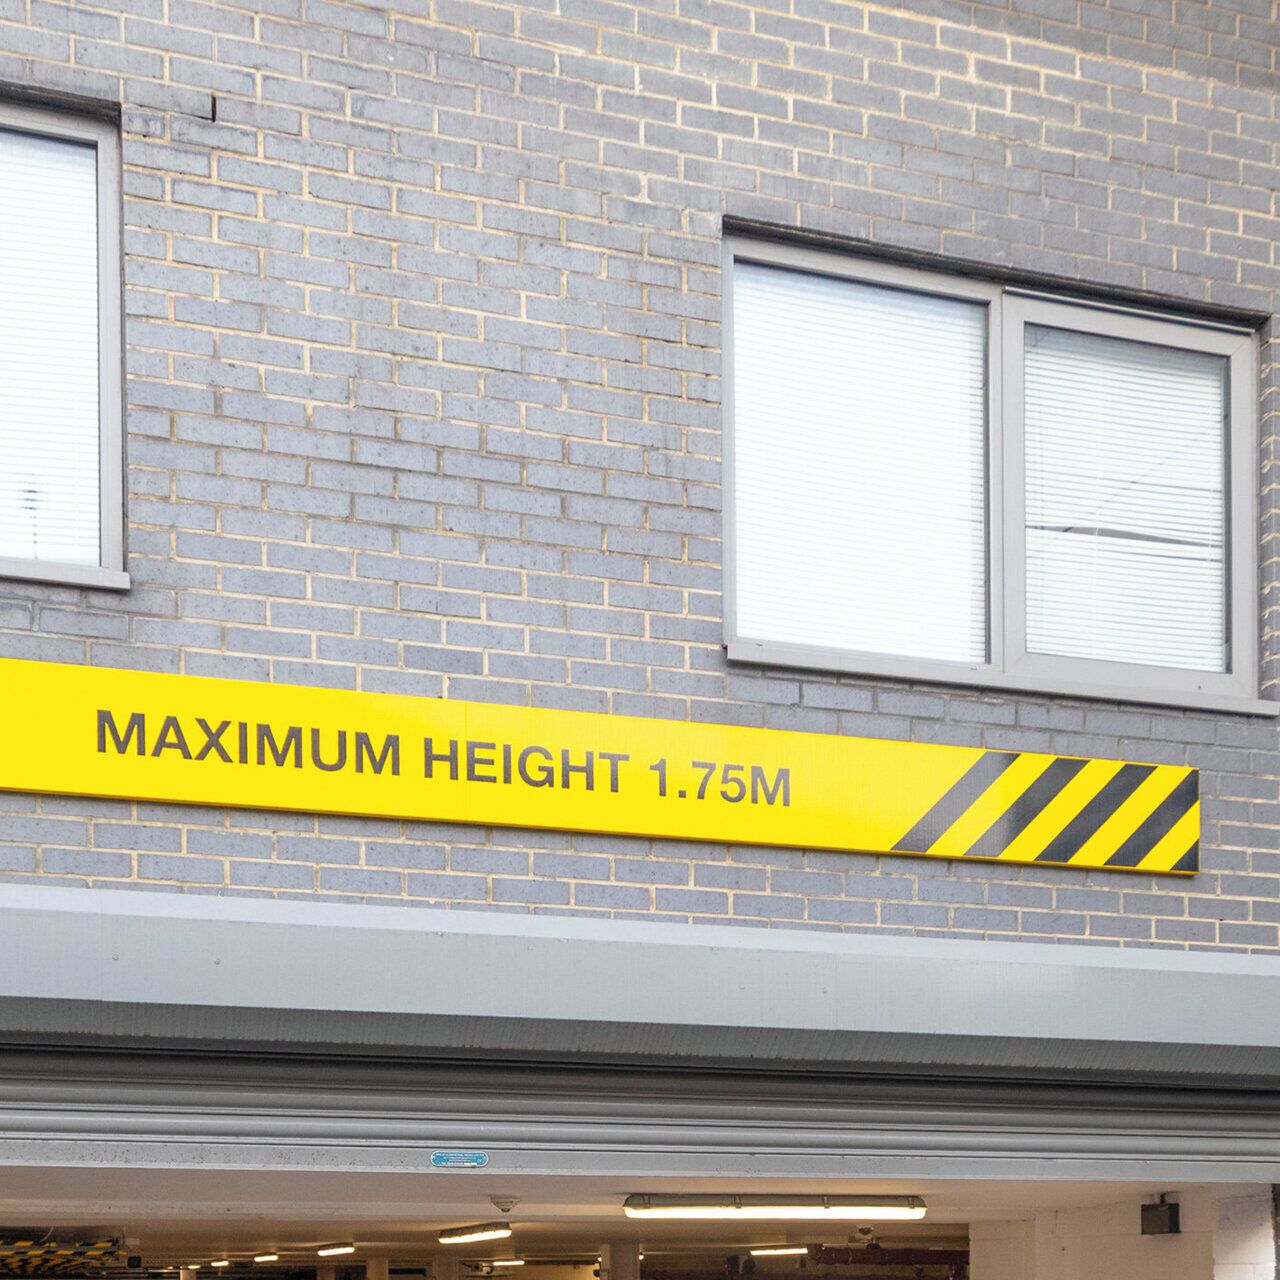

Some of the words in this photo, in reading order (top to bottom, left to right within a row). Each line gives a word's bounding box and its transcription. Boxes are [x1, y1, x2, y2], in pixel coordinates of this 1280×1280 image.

[95, 708, 402, 778] MAXIMUM
[424, 736, 631, 794] HEIGHT
[650, 758, 792, 808] 1.75M
